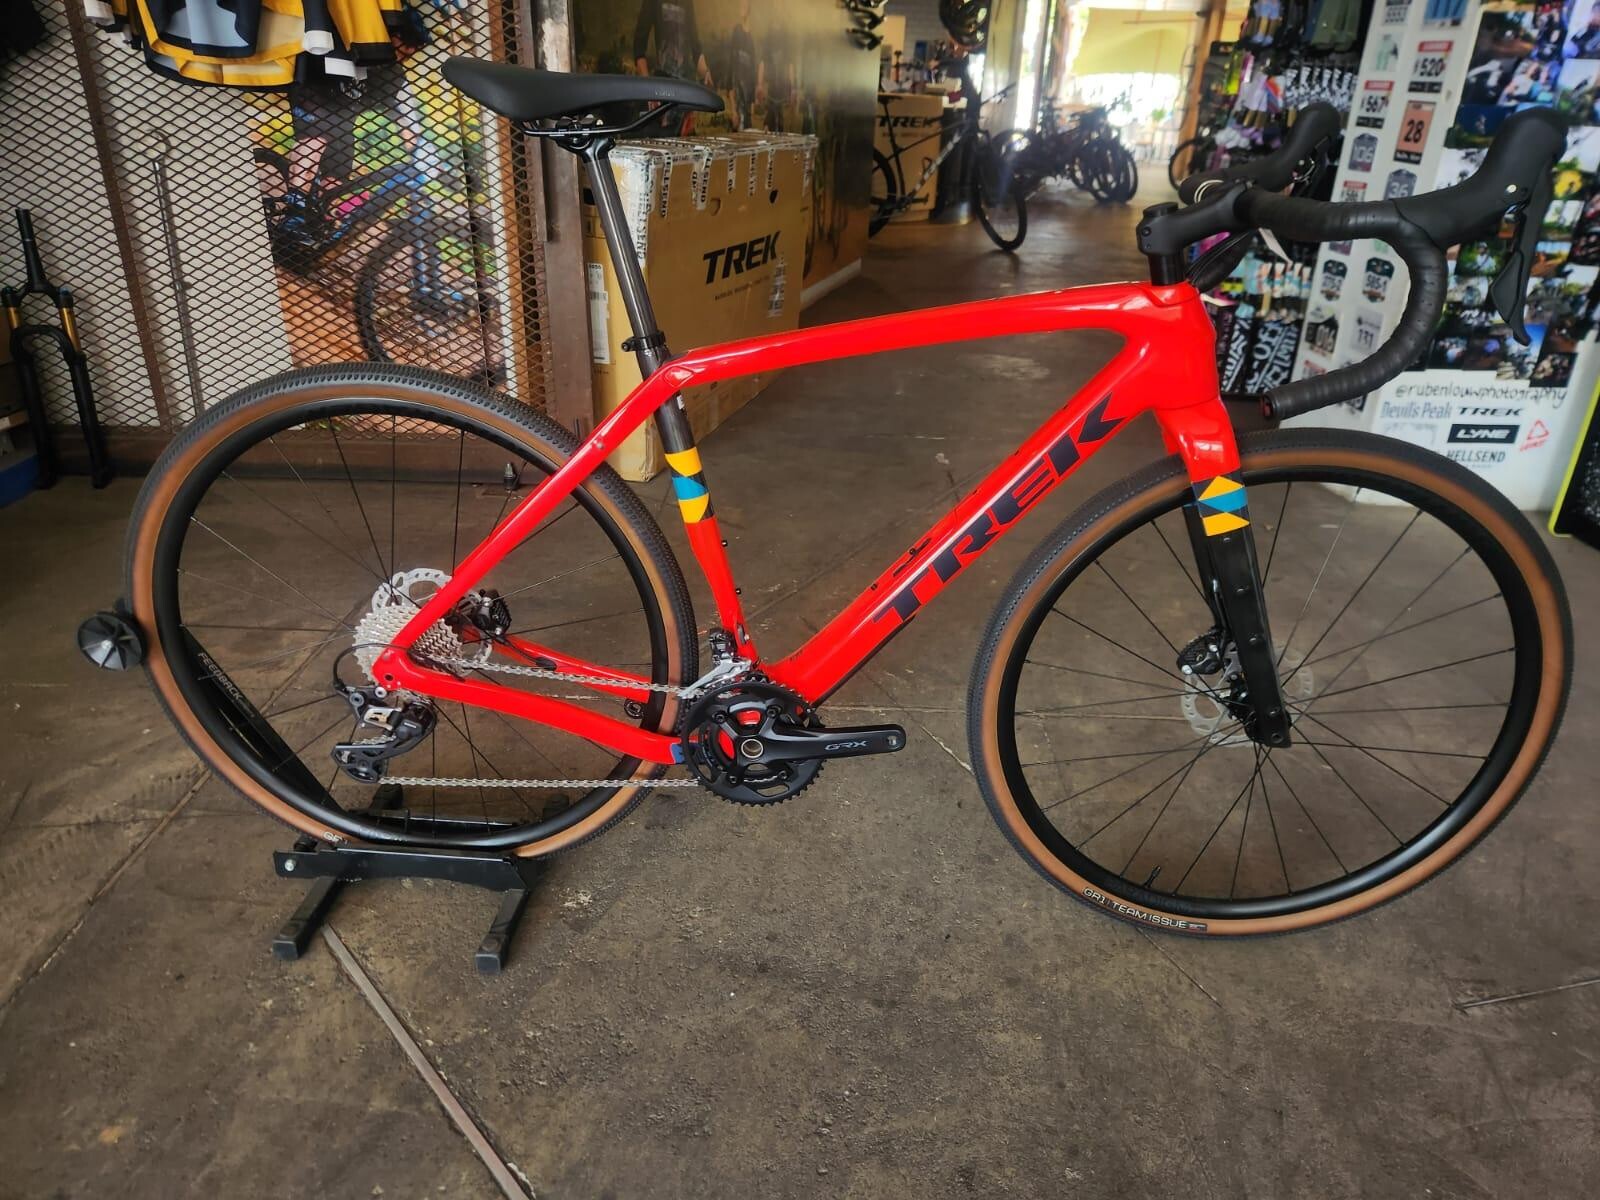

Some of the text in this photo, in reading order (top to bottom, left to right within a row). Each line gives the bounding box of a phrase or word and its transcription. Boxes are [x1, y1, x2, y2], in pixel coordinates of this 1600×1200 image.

[1404, 119, 1425, 143] 28
[1388, 182, 1409, 199] 36
[703, 230, 781, 285] TREK
[1457, 406, 1524, 416] TREK
[1456, 428, 1512, 439] LYNE
[1447, 450, 1507, 463] HELLSEND
[871, 392, 1127, 623] TREK
[198, 652, 244, 700] FEEDBACK
[824, 740, 869, 751] GRX
[1112, 901, 1148, 920] TEAM
[1149, 914, 1188, 929] ISSUE
